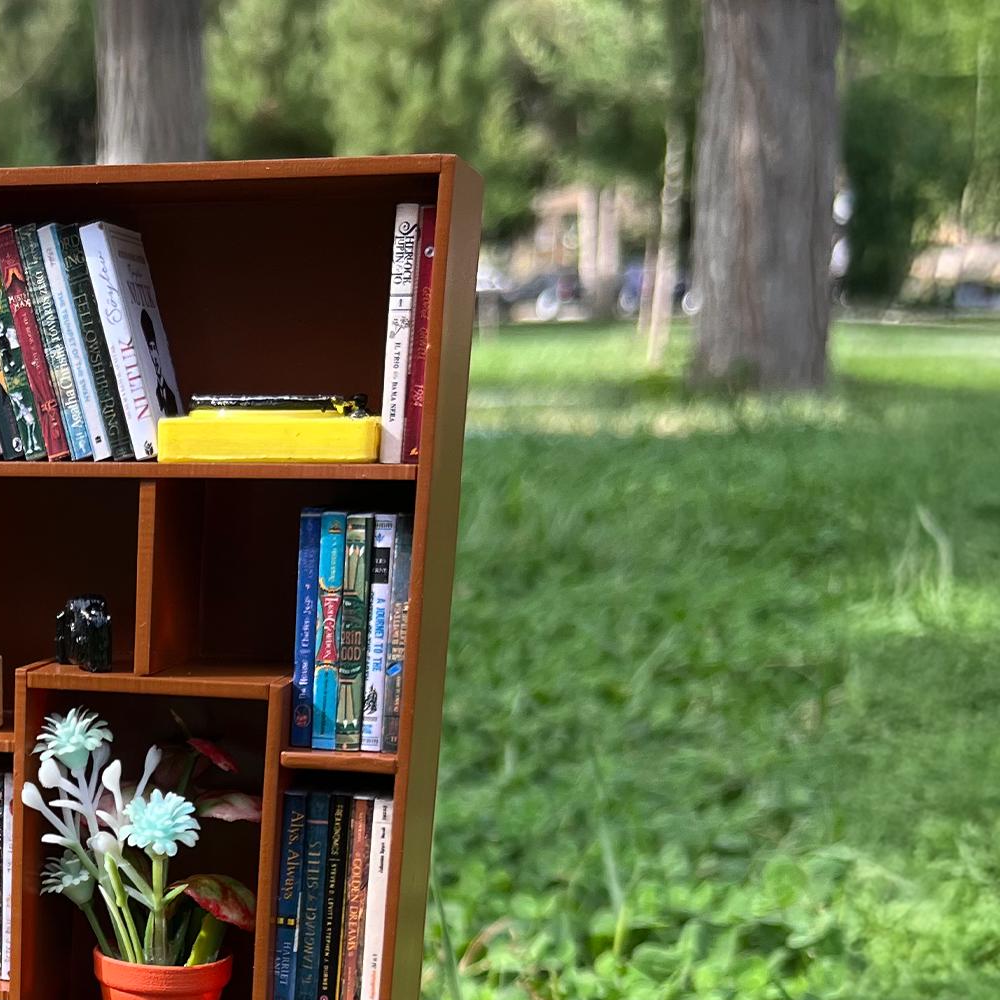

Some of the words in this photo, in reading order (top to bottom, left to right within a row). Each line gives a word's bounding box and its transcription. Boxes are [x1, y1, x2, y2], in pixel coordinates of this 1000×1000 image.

[398, 221, 420, 285] SHERLOCK
[34, 269, 48, 295] ZERO
[13, 298, 31, 313] MAX
[121, 335, 152, 421] NUTUK
[413, 384, 424, 407] 1984
[63, 388, 83, 429] Agatha
[100, 396, 121, 436] RING
[374, 607, 385, 640] JOURNEY
[372, 658, 384, 673] THE
[373, 643, 384, 653] TO
[287, 810, 305, 845] Alys,
[330, 804, 344, 855] FREAKONOMICS
[280, 850, 298, 900] Always
[307, 842, 321, 888] SPELLS
[329, 863, 337, 888] STEVEN
[350, 858, 363, 901] GOLDEN
[327, 898, 335, 920] LEVITT
[347, 906, 361, 951] DREAMS
[303, 907, 316, 969] LANGUAGE
[324, 928, 332, 956] STEPHEN
[279, 942, 292, 986] HARRIET
